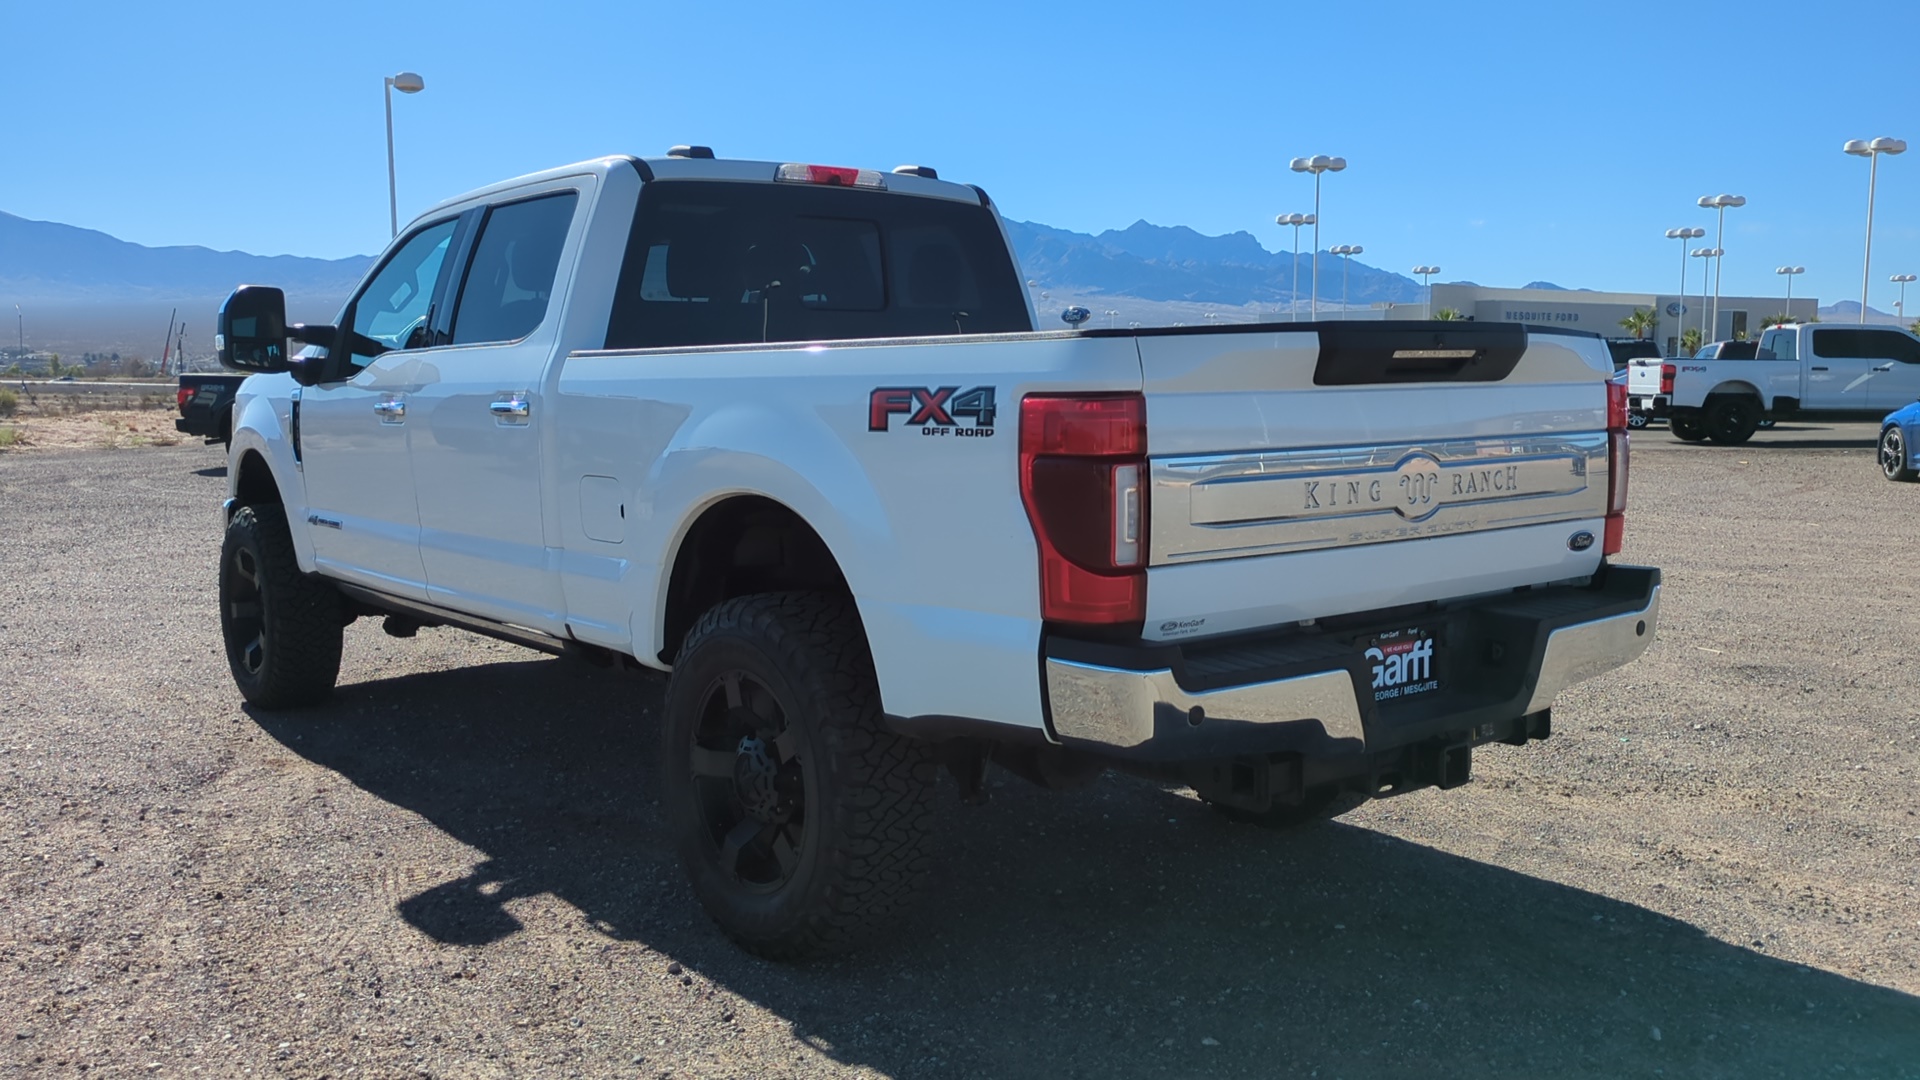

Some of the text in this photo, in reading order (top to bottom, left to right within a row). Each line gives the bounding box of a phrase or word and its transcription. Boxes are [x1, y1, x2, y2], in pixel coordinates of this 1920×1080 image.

[1506, 311, 1579, 322] MESQUITE FORD
[868, 385, 997, 432] FX4
[922, 427, 994, 438] OFF ROAD
[1304, 466, 1518, 509] KING RANCH
[1349, 519, 1477, 541] SUPER DUTY
[1364, 638, 1433, 689] Garff
[1375, 687, 1399, 701] EORGE
[1404, 680, 1438, 695] MESQUITE
